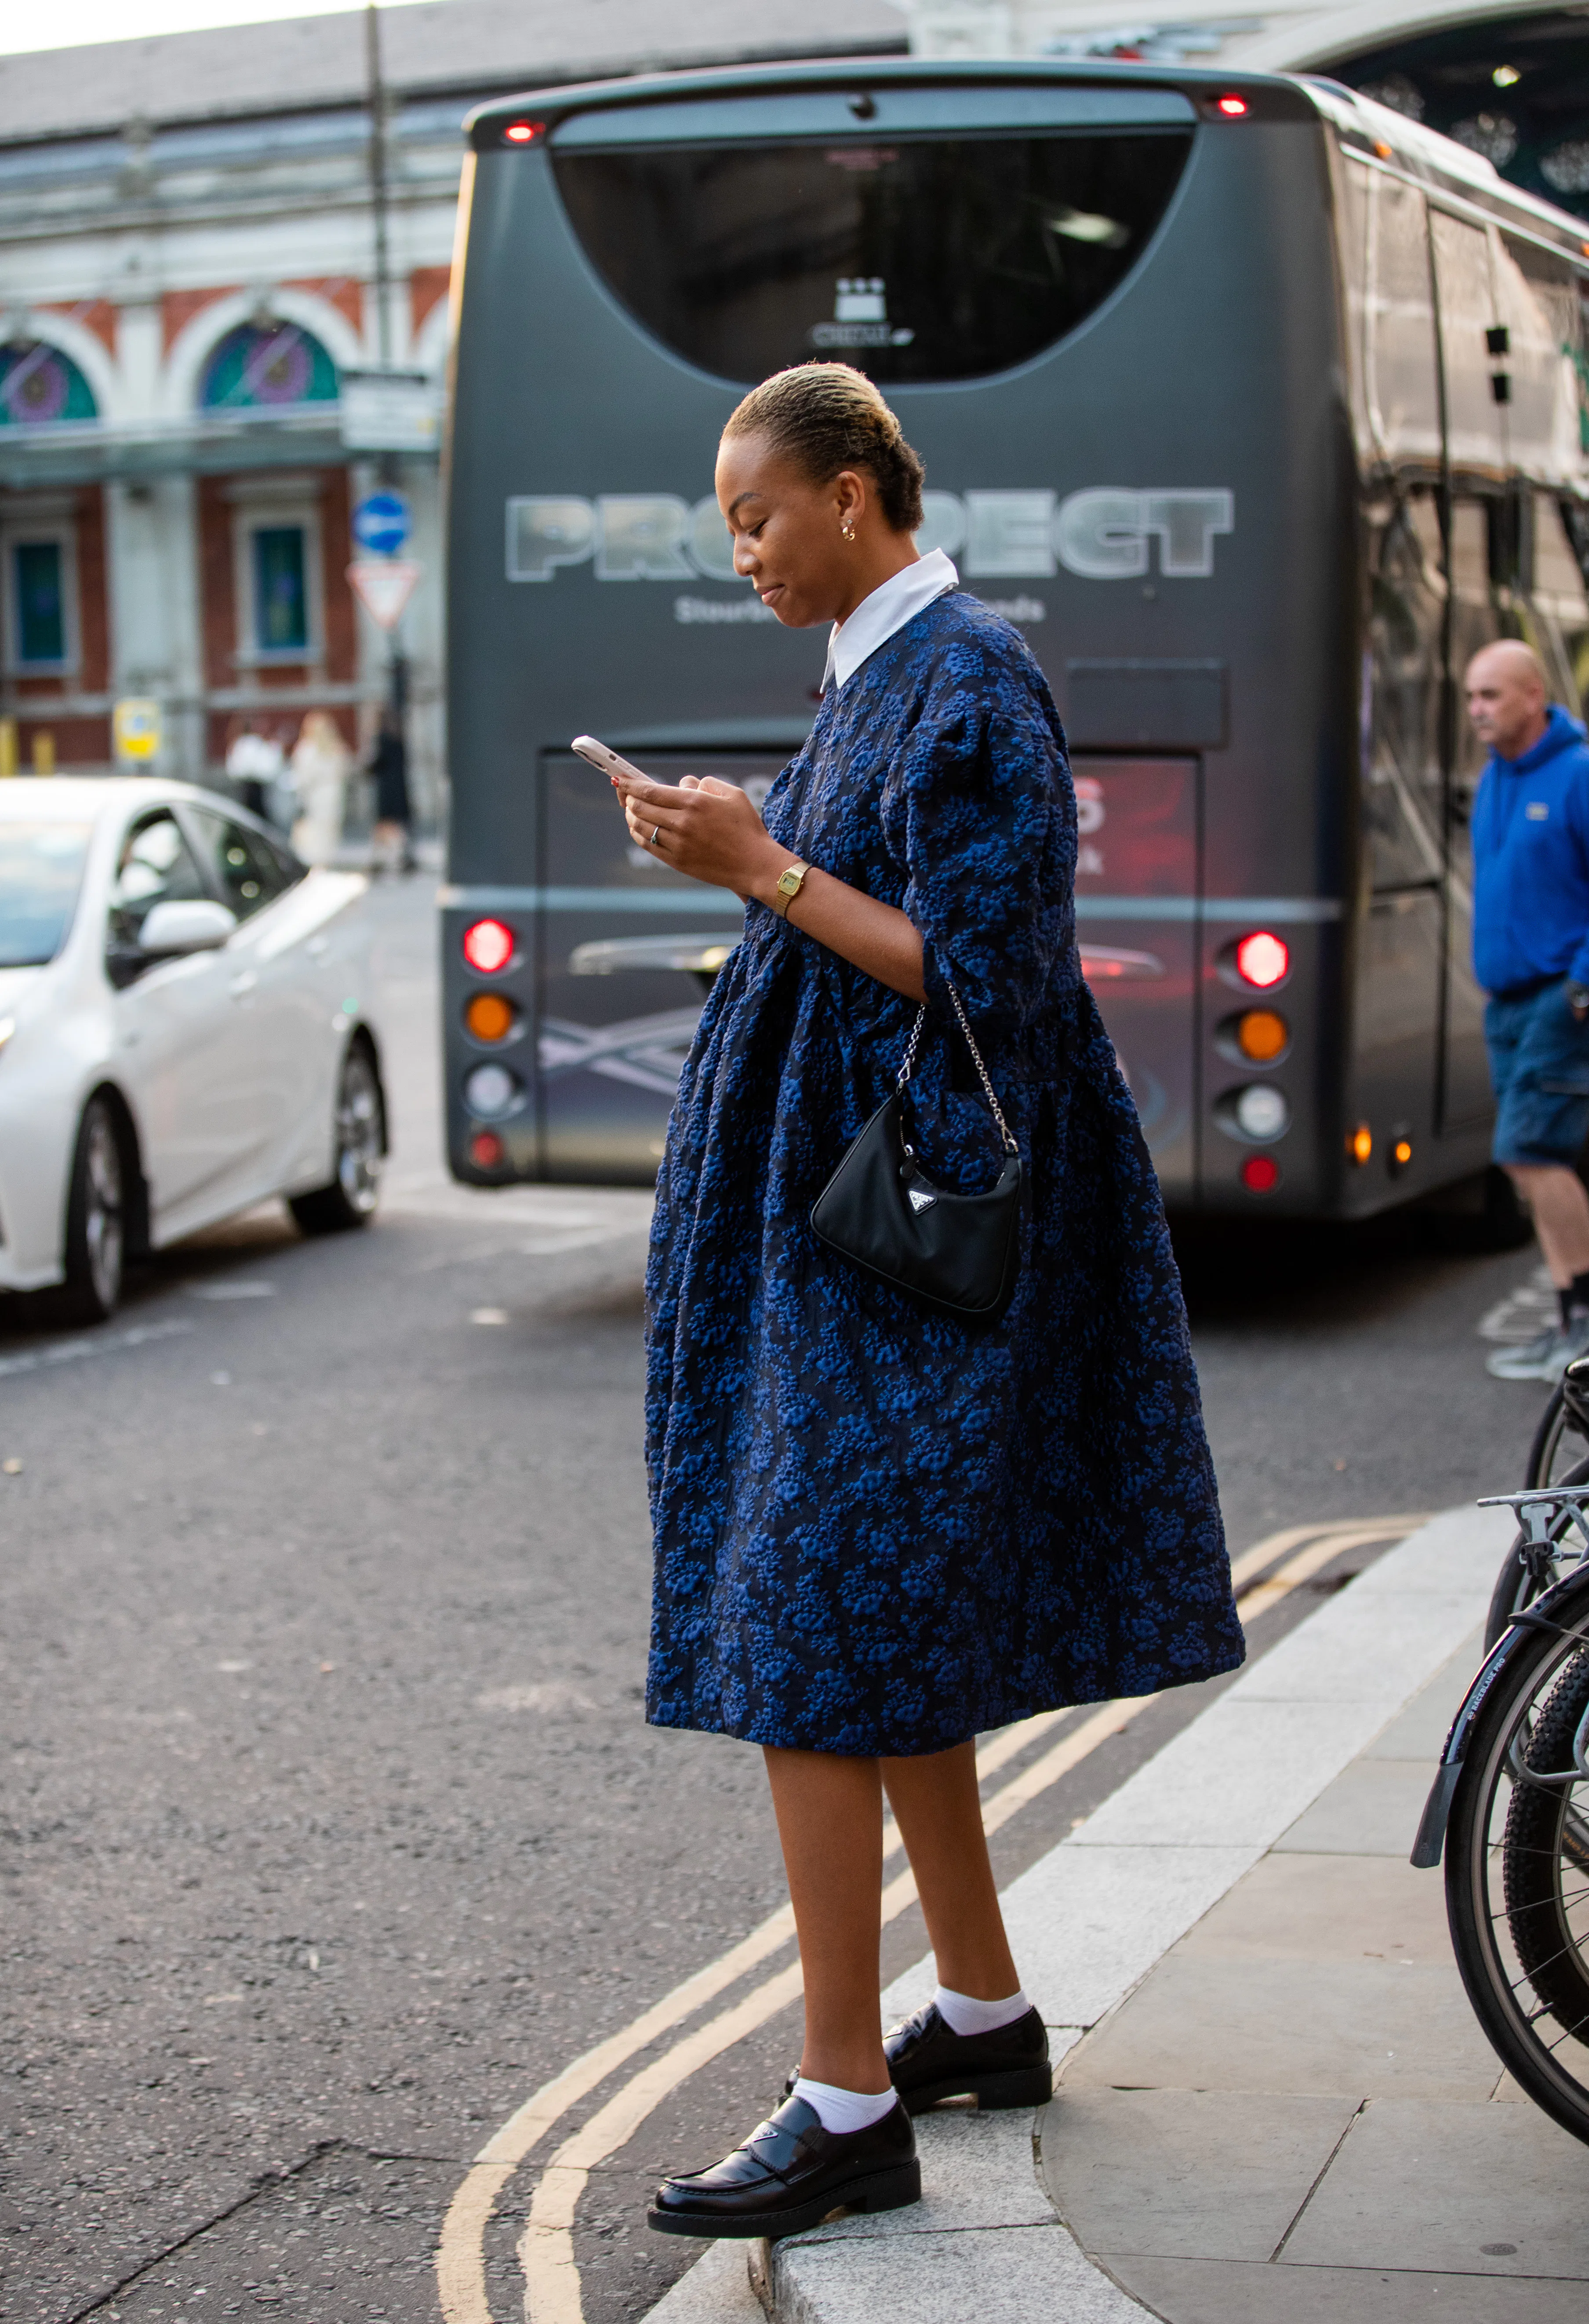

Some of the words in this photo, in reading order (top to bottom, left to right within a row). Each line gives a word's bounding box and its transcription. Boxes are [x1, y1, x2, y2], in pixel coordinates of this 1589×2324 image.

[505, 485, 1235, 583] PRECT
[1471, 1670, 1496, 1711] RACEBLADE
[1493, 1657, 1505, 1672] PRO
